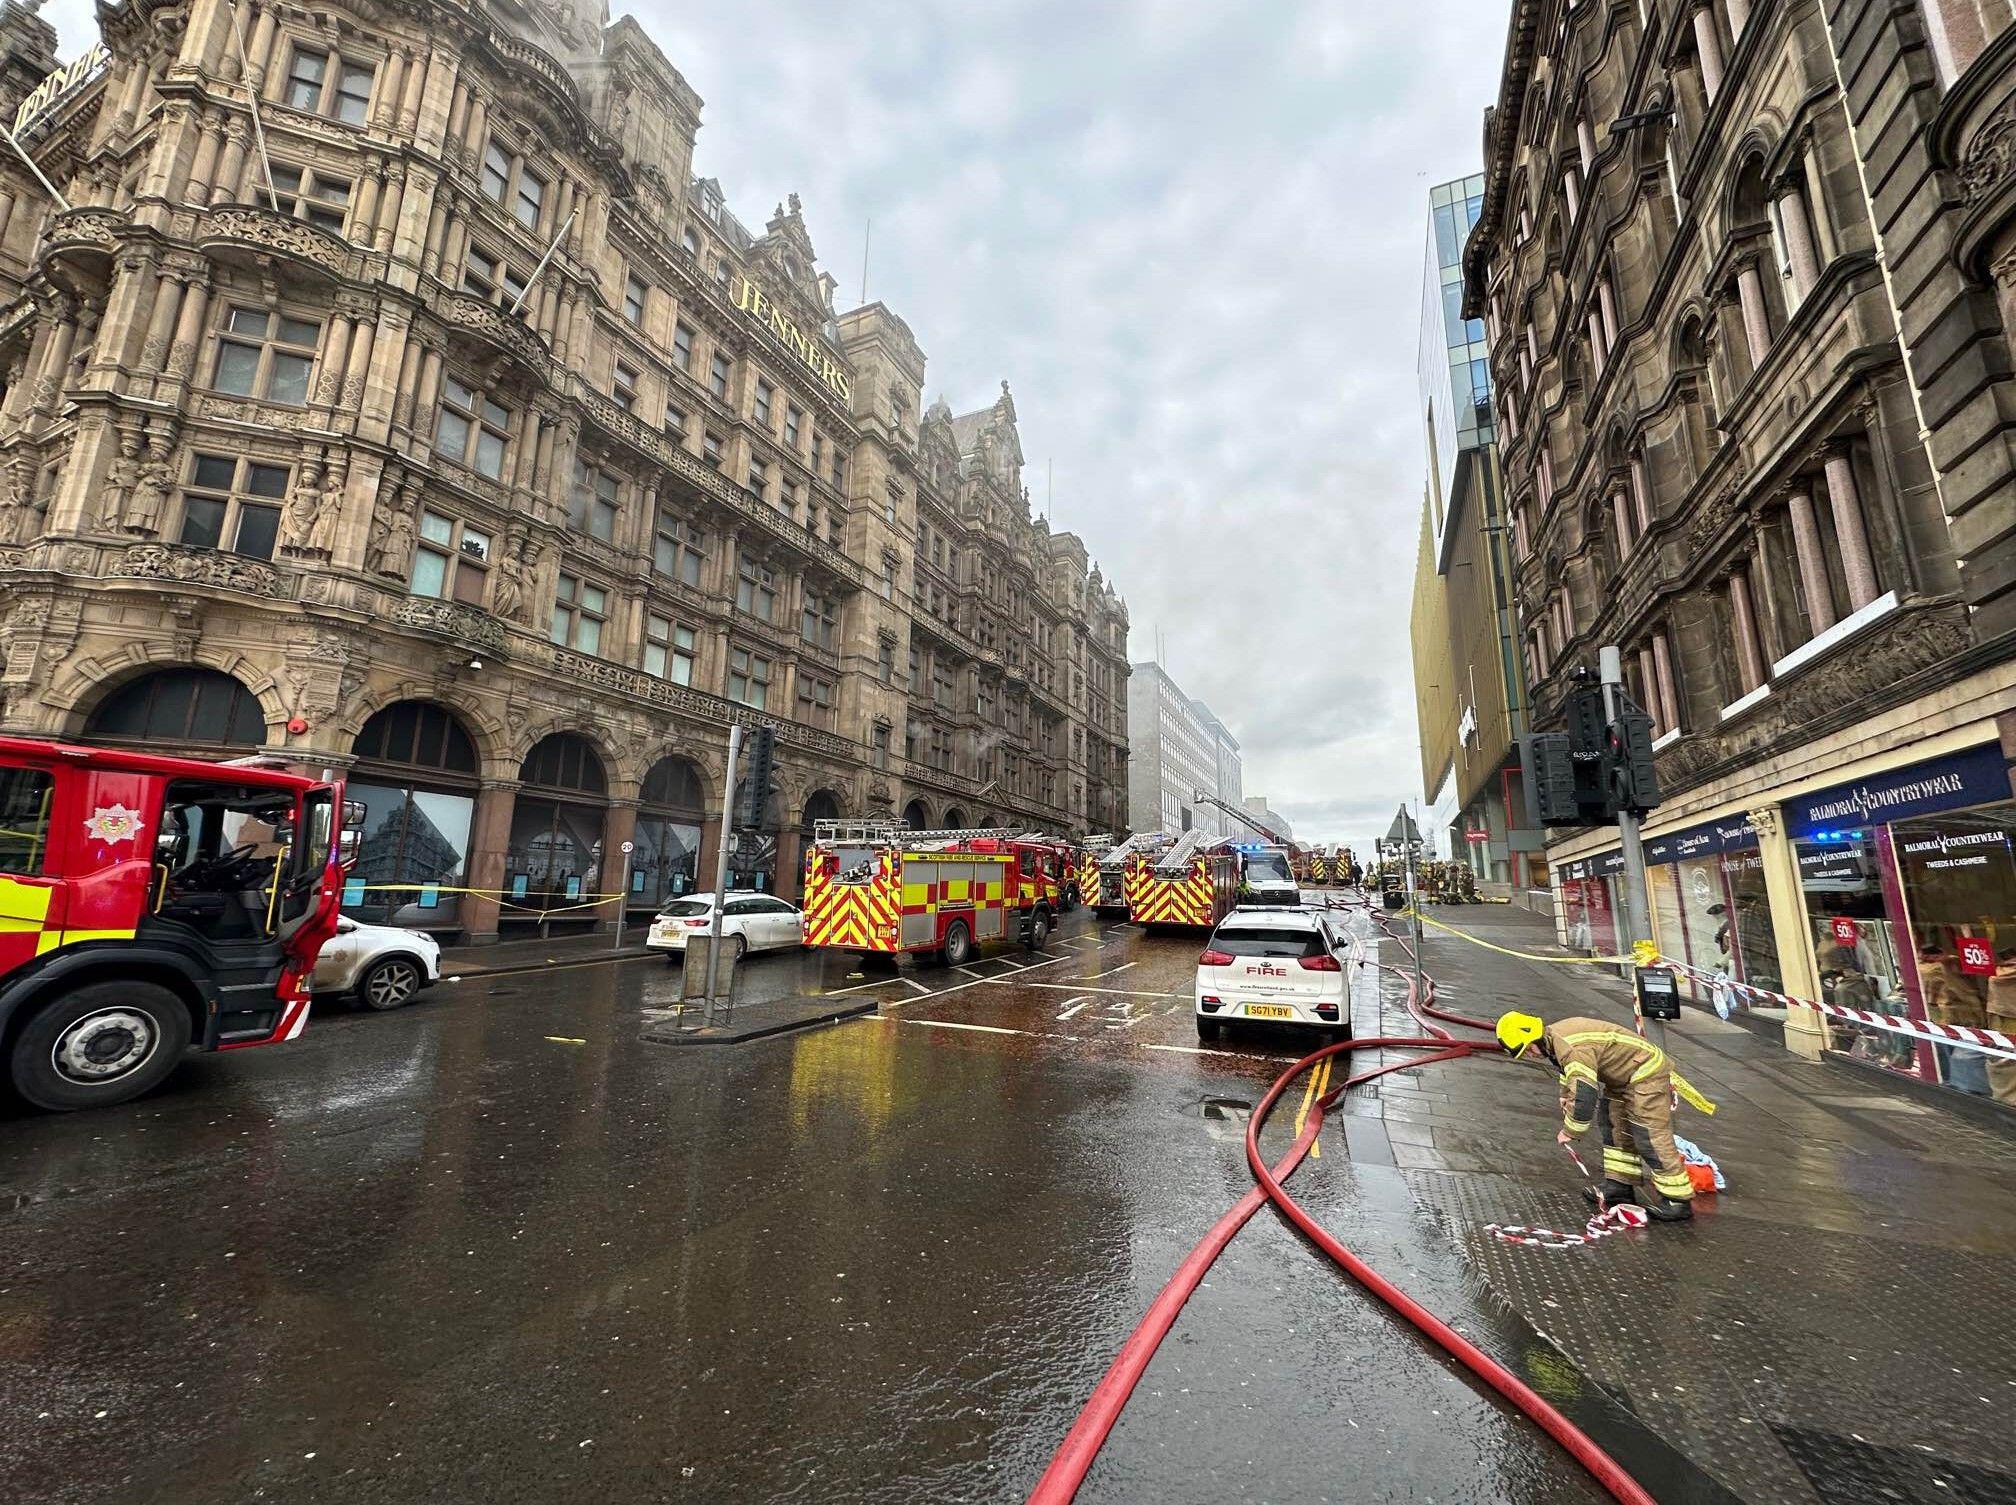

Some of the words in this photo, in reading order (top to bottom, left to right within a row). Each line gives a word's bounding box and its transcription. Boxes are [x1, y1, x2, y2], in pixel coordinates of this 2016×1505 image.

[729, 273, 850, 400] JENNERS
[1809, 799, 1860, 822] BALMORAL
[1866, 773, 1964, 811] COUNTRYWEAR
[1904, 839, 1941, 853] BALMORAL
[1945, 831, 2005, 848] COUNTRYWEAR
[1800, 854, 1822, 865] BALMORAL
[1825, 849, 1863, 860] COUNTRYWEAR
[1926, 859, 1949, 869] TWEEDS
[1955, 855, 1988, 866] CASHMERE
[1246, 966, 1287, 977] FIRE
[1251, 1006, 1270, 1015] SG71
[1272, 1007, 1288, 1016] YBV
